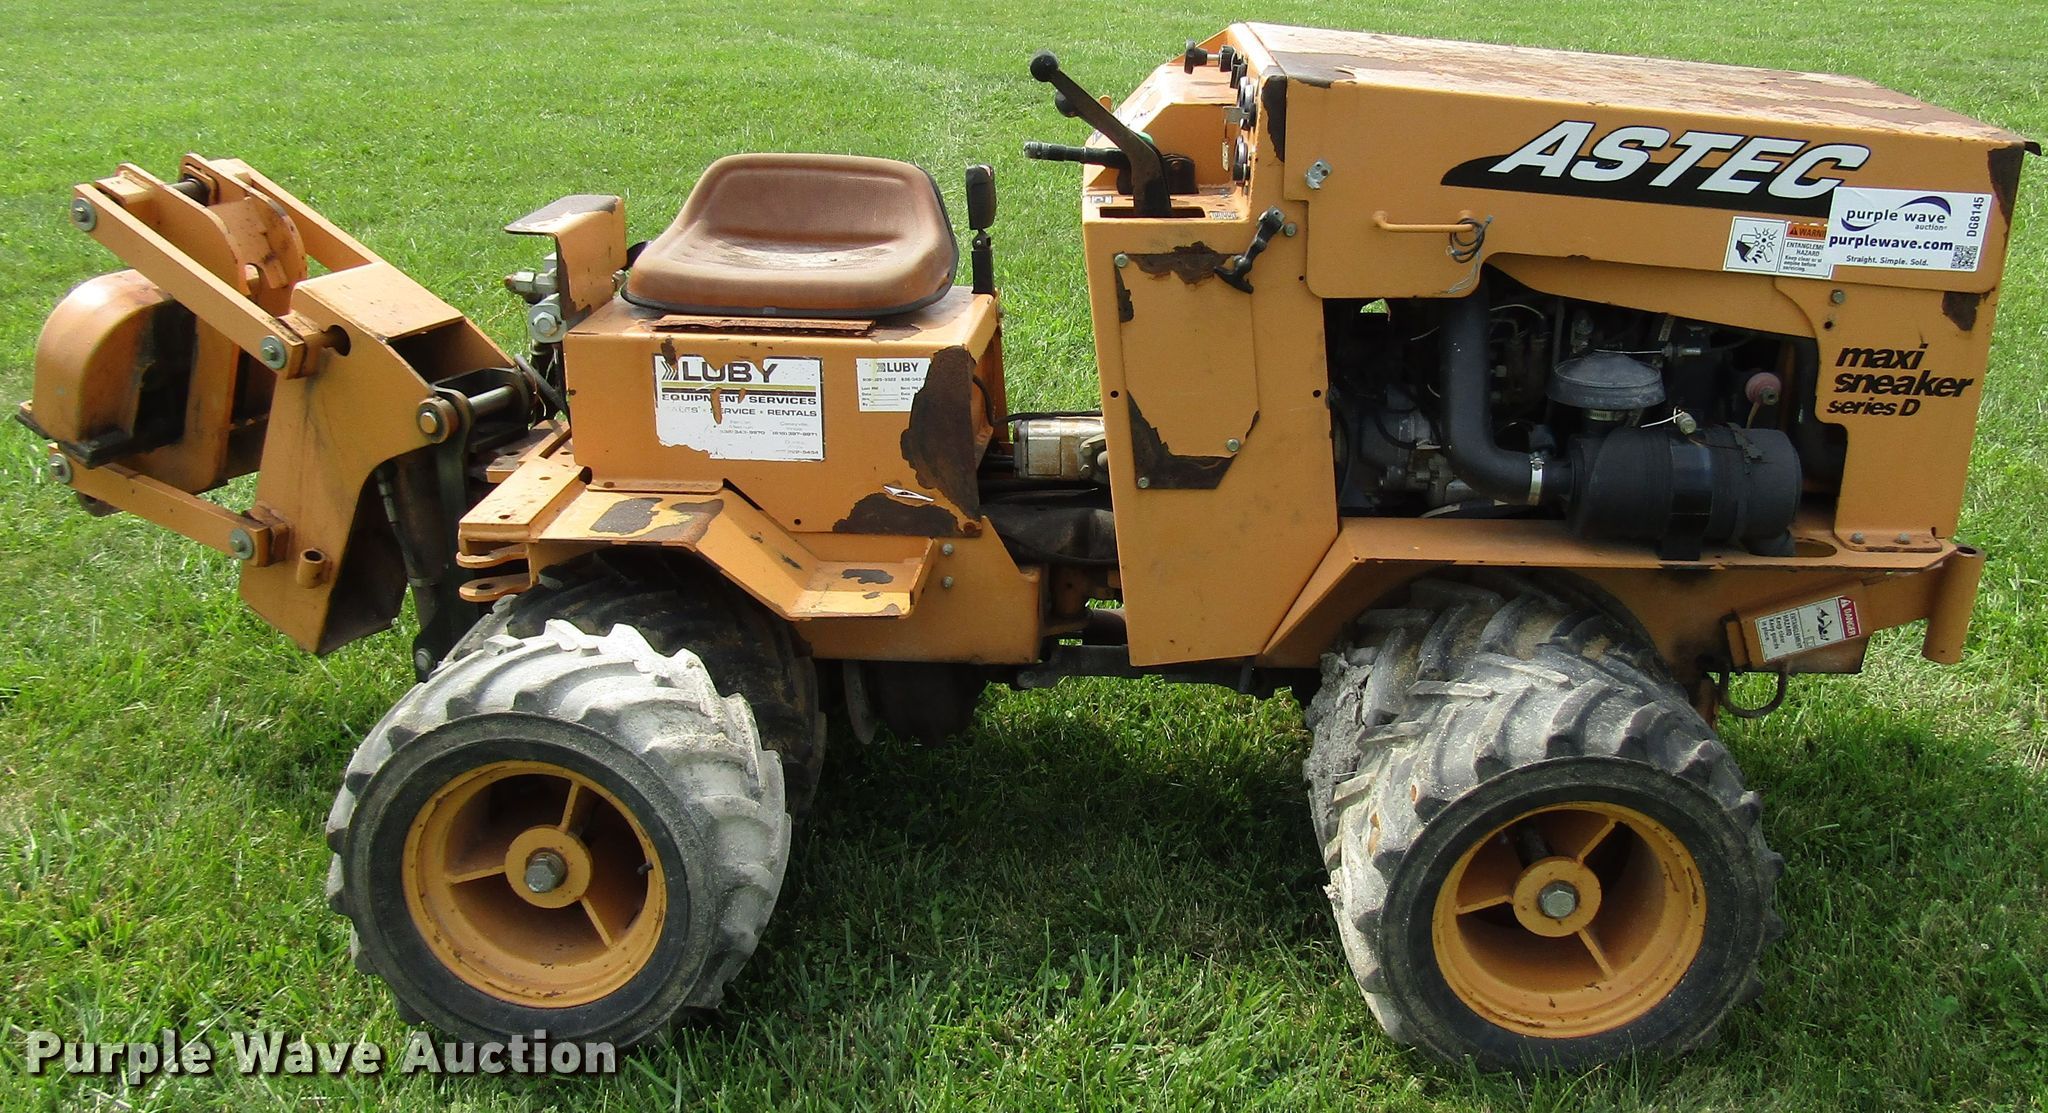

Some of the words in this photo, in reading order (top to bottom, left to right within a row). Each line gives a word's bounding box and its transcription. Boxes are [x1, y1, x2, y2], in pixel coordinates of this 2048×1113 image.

[1489, 120, 1871, 200] ASTEC
[1846, 209, 1898, 222] purple
[1904, 213, 1946, 223] wave
[1966, 197, 1985, 237] DG8145
[1799, 228, 1826, 237] WARNI
[1829, 234, 1953, 251] purplewave.com
[1846, 255, 1878, 264] Straight.
[1880, 256, 1908, 266] Simple.
[1910, 258, 1929, 266] Sold.
[1835, 343, 1928, 369] maxi
[682, 361, 779, 383] LUBY
[887, 362, 919, 373] LUBY
[1833, 370, 1974, 397] sneaker
[749, 396, 817, 405] SERVICES
[1826, 397, 1898, 416] series
[1898, 398, 1921, 416] D
[767, 409, 817, 417] RENTALS
[1783, 614, 1793, 637] HAZARD
[1790, 612, 1802, 649] ENTANGLEMENT
[1845, 608, 1856, 637] DANGER
